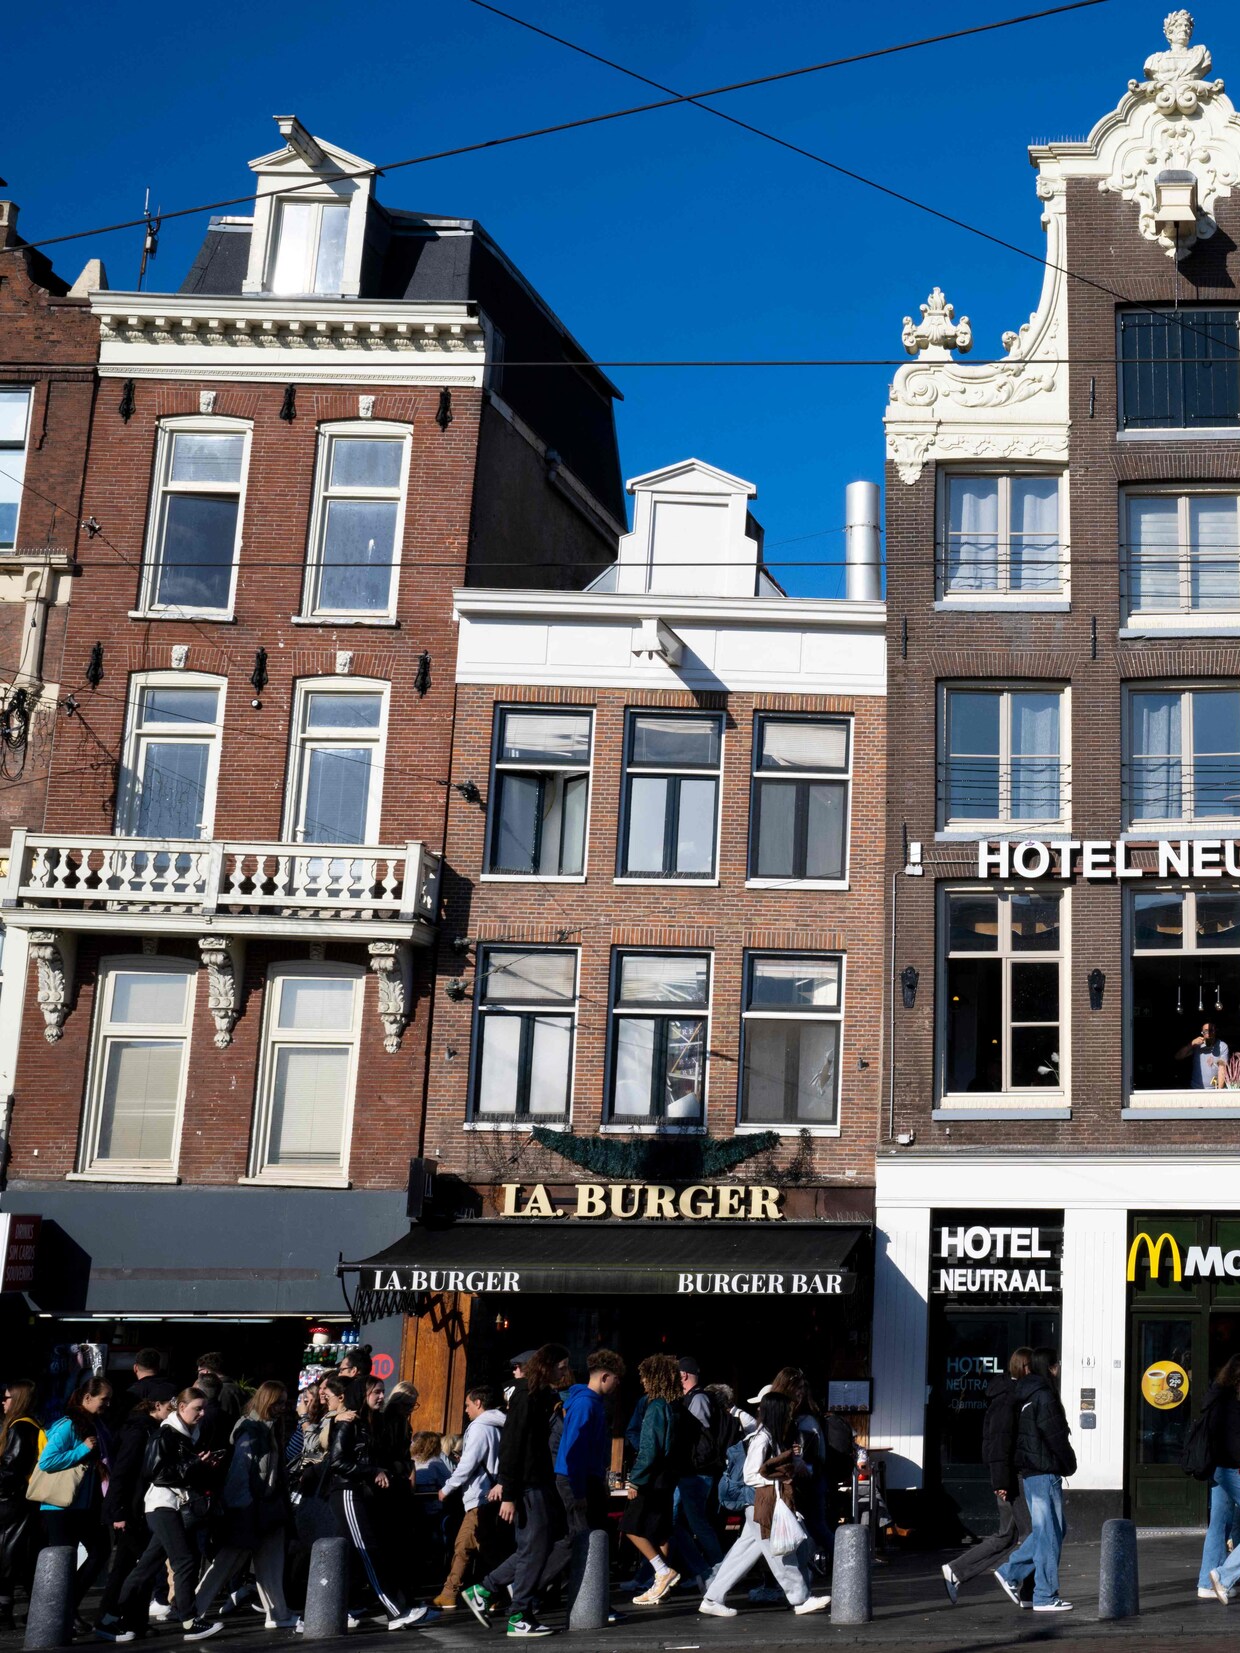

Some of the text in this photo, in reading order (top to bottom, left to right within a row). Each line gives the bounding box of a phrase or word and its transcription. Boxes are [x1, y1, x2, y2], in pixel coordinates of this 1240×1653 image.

[978, 840, 1143, 878] HOTEL
[573, 1184, 784, 1220] BURGER
[940, 1225, 1051, 1259] HOTEL
[410, 1270, 521, 1292] BURGER
[676, 1273, 843, 1294] BURGER BAR
[939, 1268, 1053, 1292] NEUTRAAL
[373, 1359, 391, 1376] 10
[947, 1356, 1004, 1374] HOTEL
[946, 1379, 988, 1391] NEUTRA
